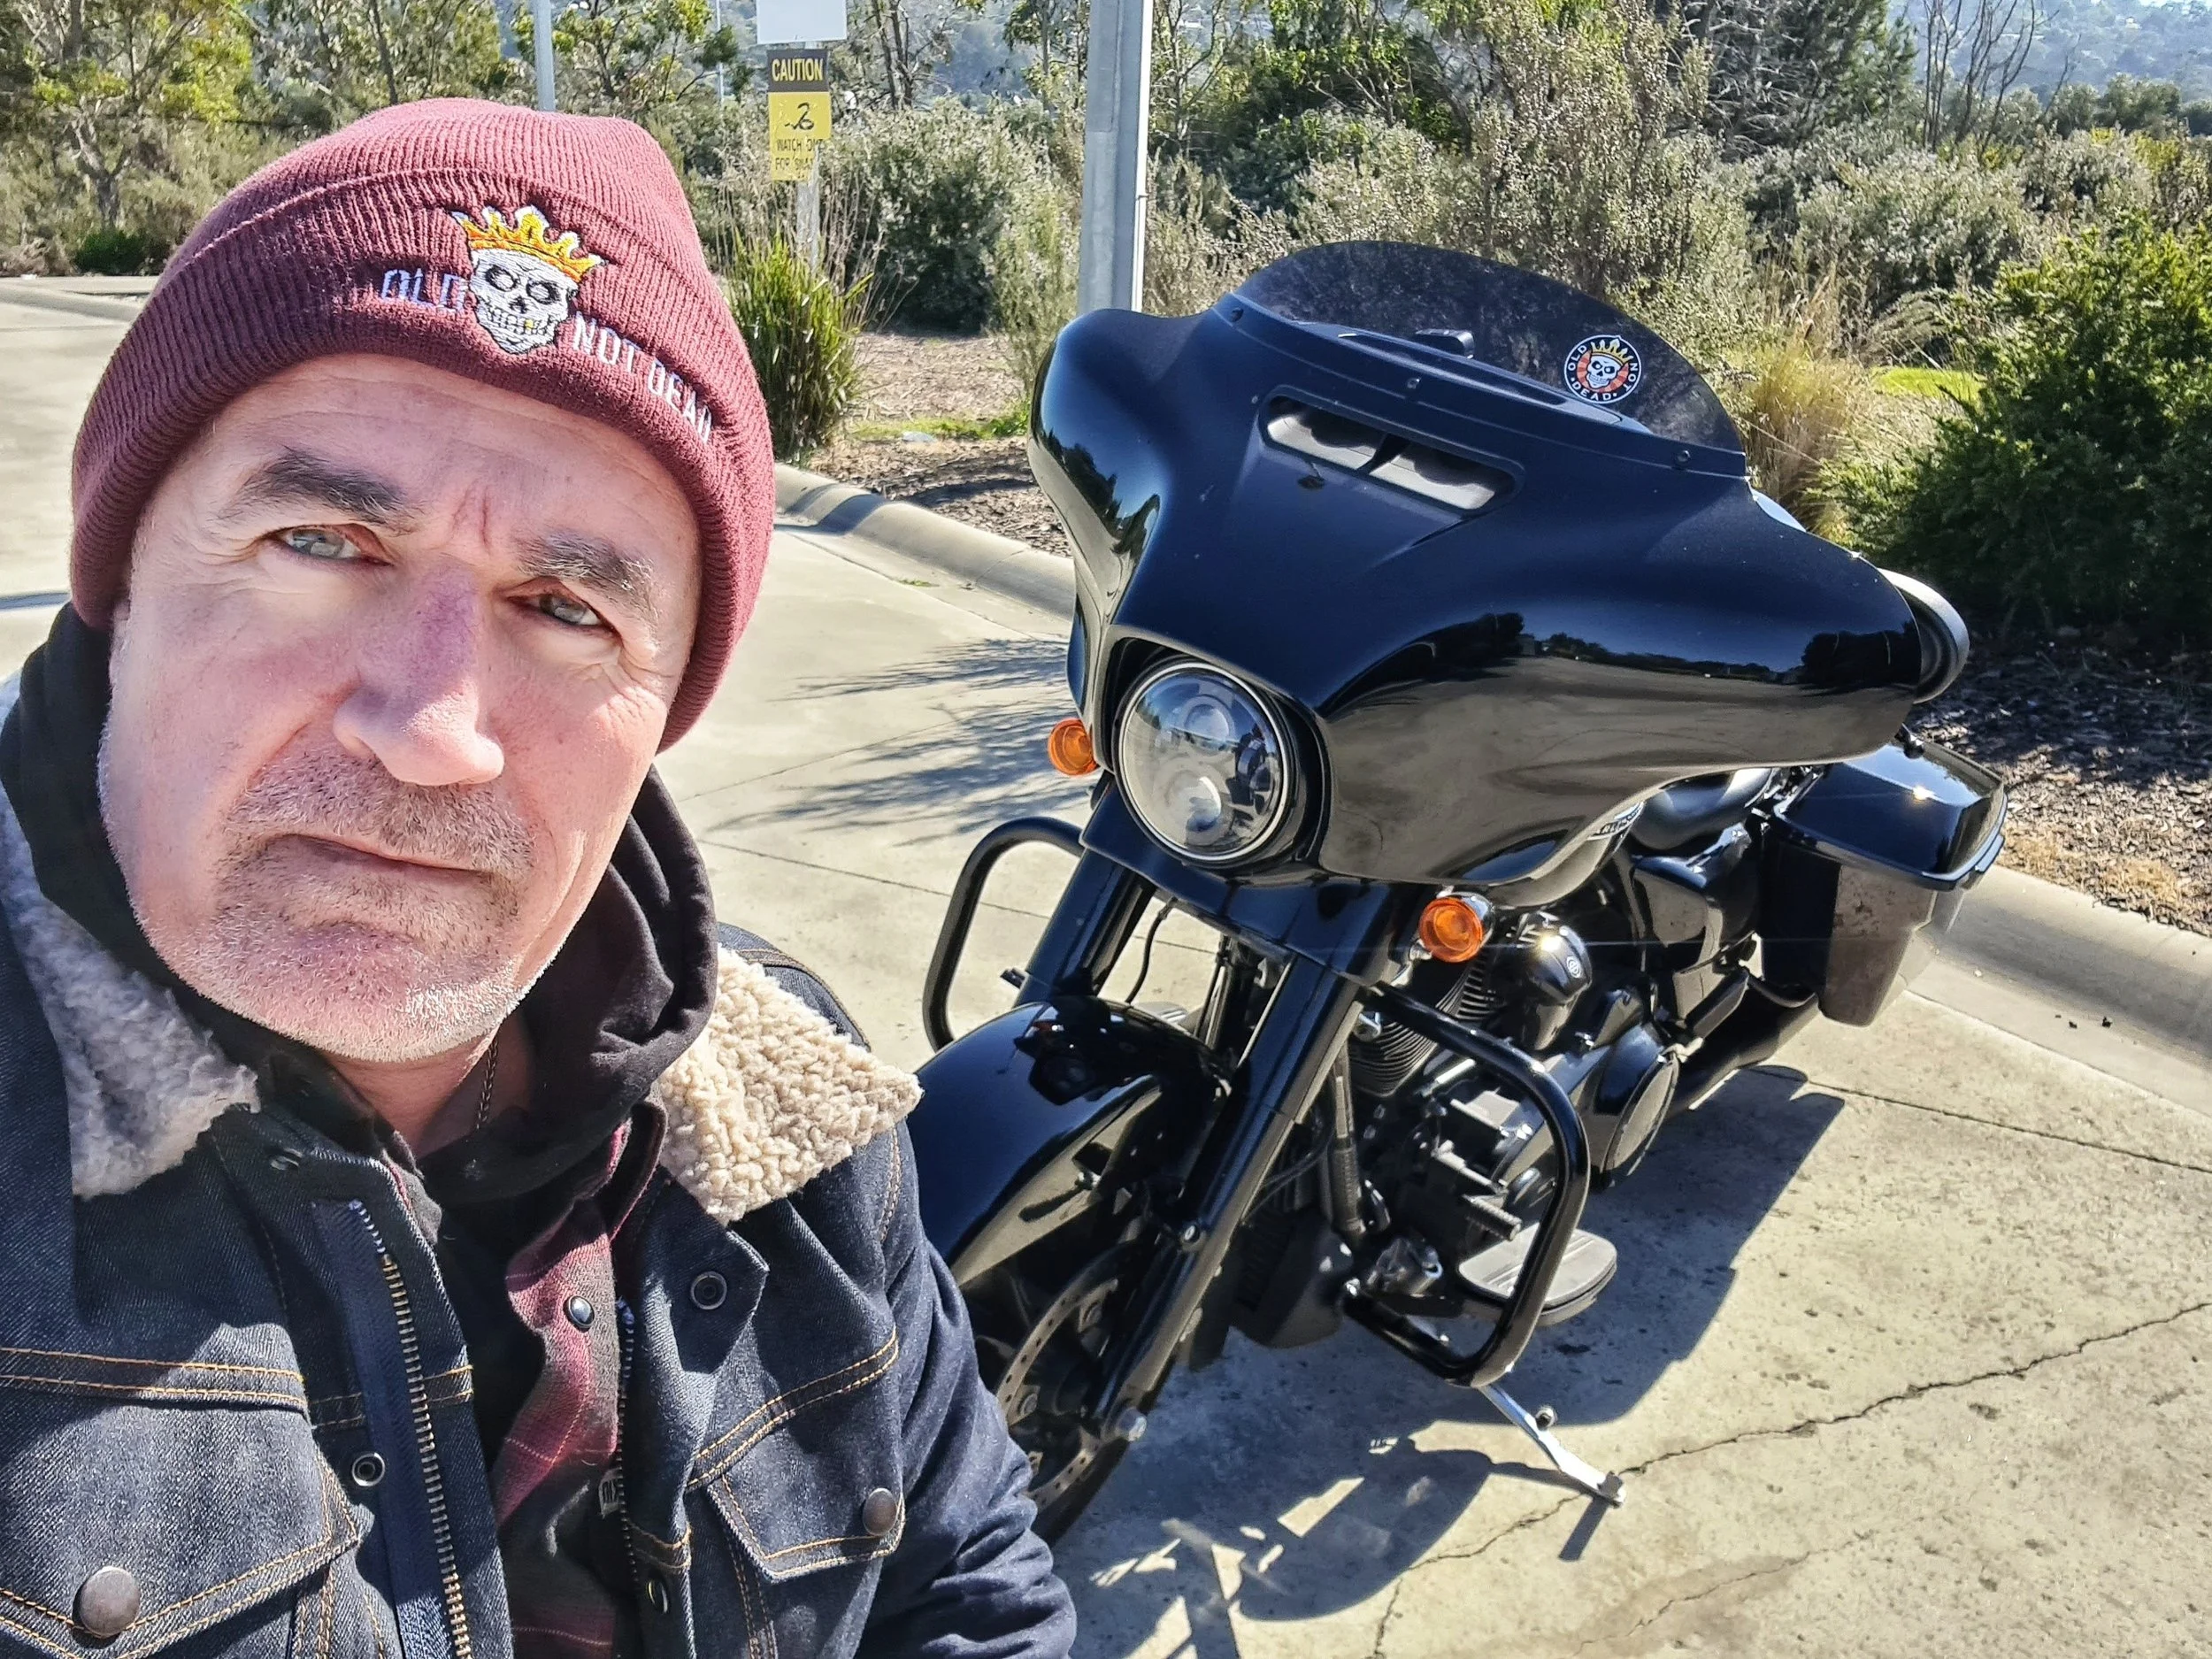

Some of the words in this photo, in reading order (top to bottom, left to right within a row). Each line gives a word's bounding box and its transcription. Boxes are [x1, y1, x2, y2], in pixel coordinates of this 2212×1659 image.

[772, 58, 823, 81] CAUTION
[777, 139, 802, 152] WATCH
[381, 268, 468, 313] OLD
[572, 311, 641, 373] NOT
[648, 357, 711, 443] DEAD
[1568, 345, 1587, 372] OLD
[1623, 363, 1639, 391] NOT
[1572, 381, 1611, 401] DEAD
